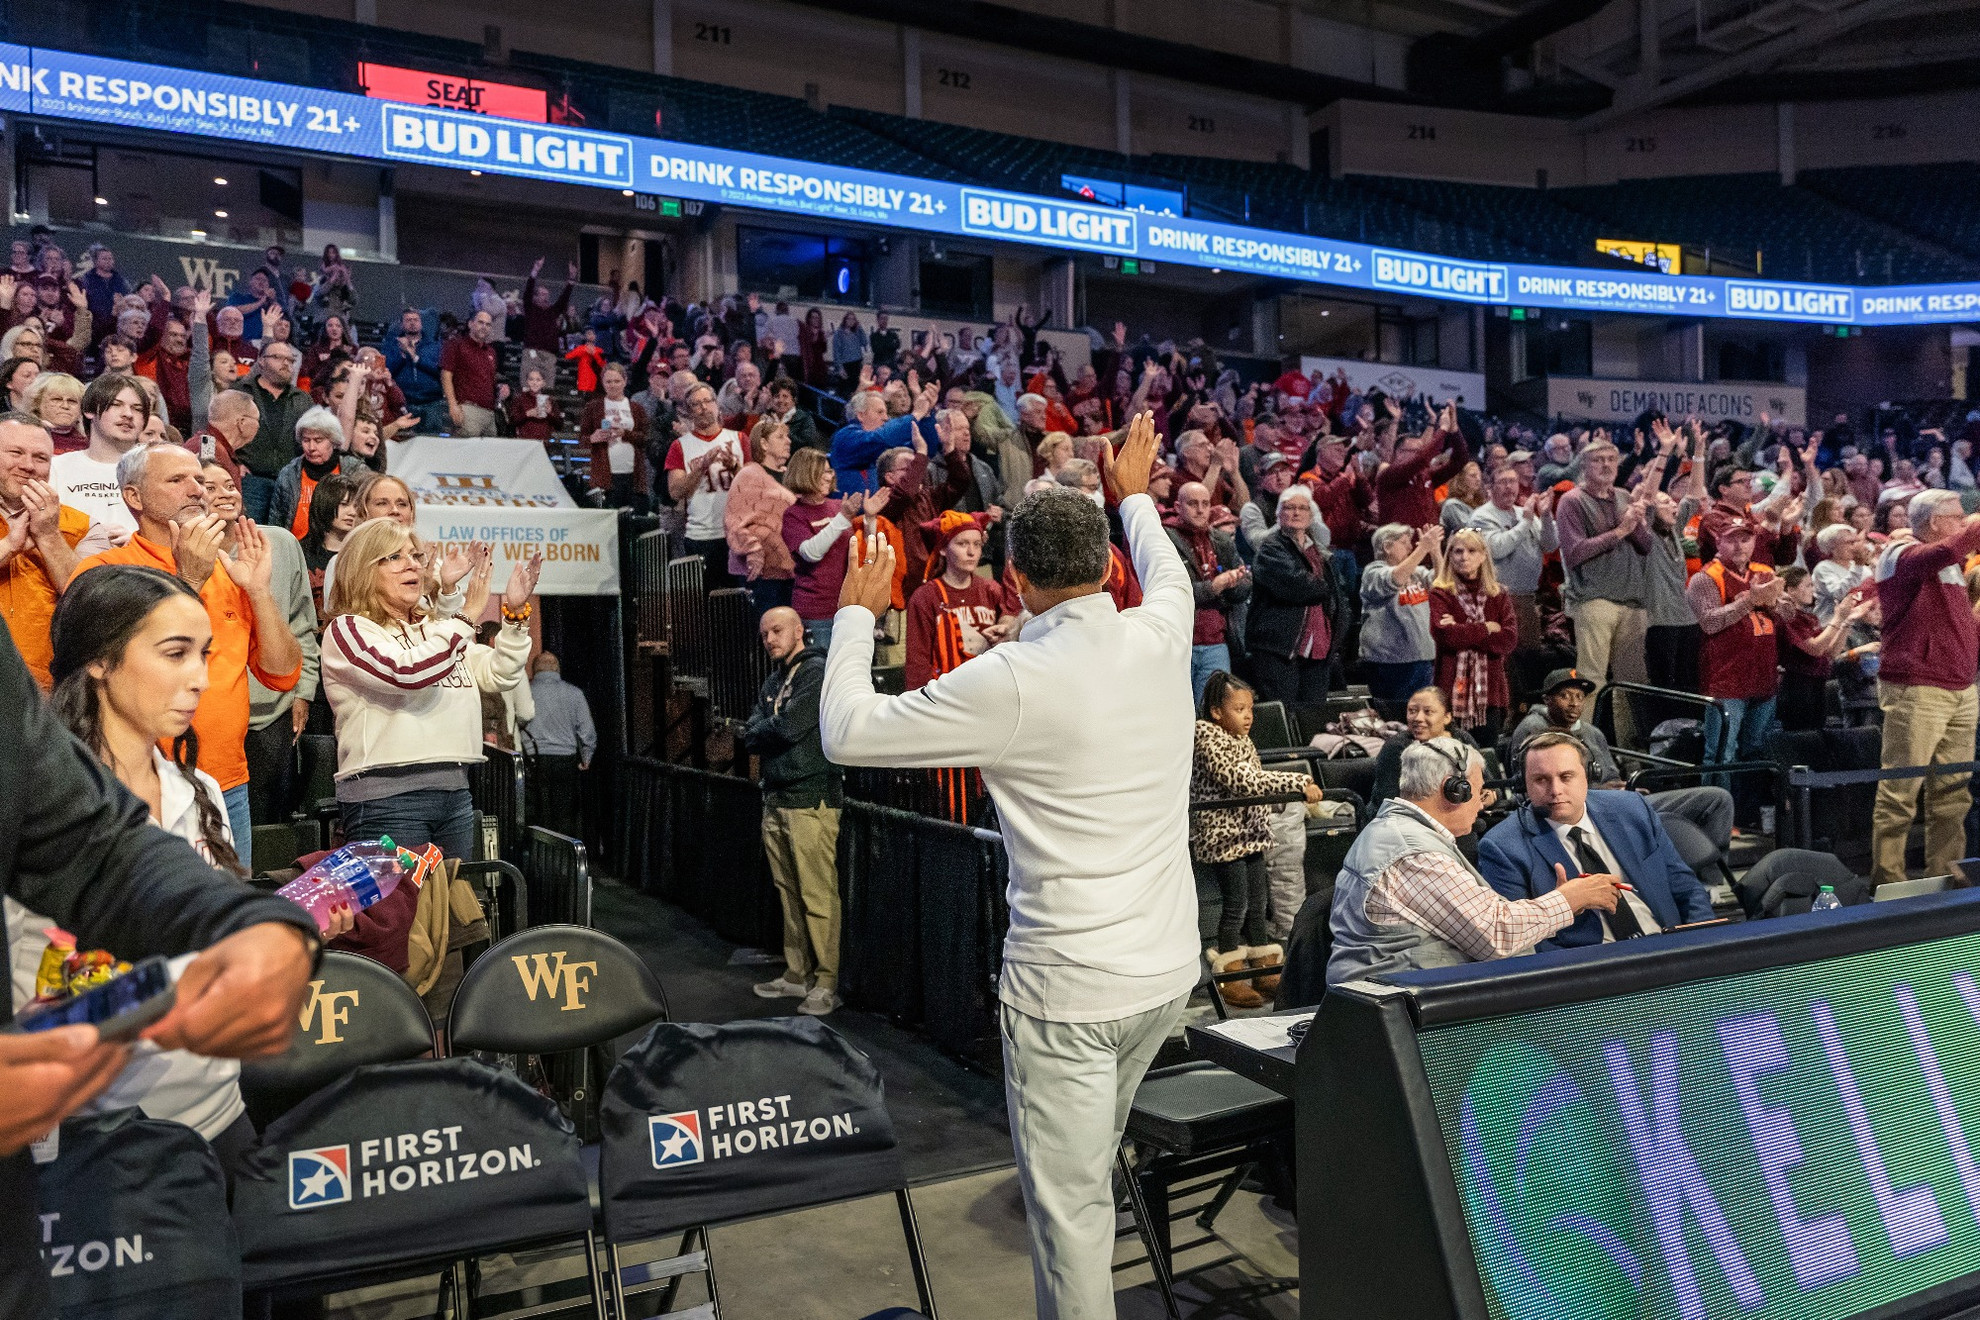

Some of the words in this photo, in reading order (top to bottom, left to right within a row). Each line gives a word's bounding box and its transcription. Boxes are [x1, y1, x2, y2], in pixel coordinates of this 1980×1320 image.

[696, 22, 731, 45] 211
[427, 79, 485, 106] SEAT
[938, 68, 972, 89] 212
[59, 70, 299, 128] RESPONSIBLY
[306, 106, 361, 134] 21+
[392, 114, 491, 157] BUD
[496, 128, 624, 176] LIGHT
[650, 155, 735, 188] DRINK
[740, 166, 905, 210] RESPONSIBLY
[909, 193, 947, 215] 21+
[968, 197, 1037, 231] BUD
[1040, 207, 1130, 245] LIGHT
[1149, 226, 1209, 253] DRINK
[1212, 236, 1331, 270] RESPONSIBLY
[1334, 253, 1362, 273] 21+
[179, 256, 240, 298] WF
[1377, 257, 1428, 284] BUD
[1430, 262, 1502, 295] LIGHT
[1518, 276, 1572, 297] DRINK
[1576, 279, 1686, 303] RESPONSIBLY
[1689, 286, 1715, 304] 21+
[1730, 287, 1782, 311] BUD
[1783, 290, 1849, 315] LIGHT
[1862, 296, 1923, 315] DRINK
[1927, 294, 1980, 312] RESP
[1610, 389, 1670, 412] DEMON
[1674, 392, 1753, 416] DEACONS
[439, 525, 475, 540] LAW
[480, 526, 544, 542] OFFICES
[550, 528, 569, 542] OF
[512, 951, 597, 1011] WF
[708, 1095, 791, 1130] FIRST
[361, 1126, 462, 1167] FIRST
